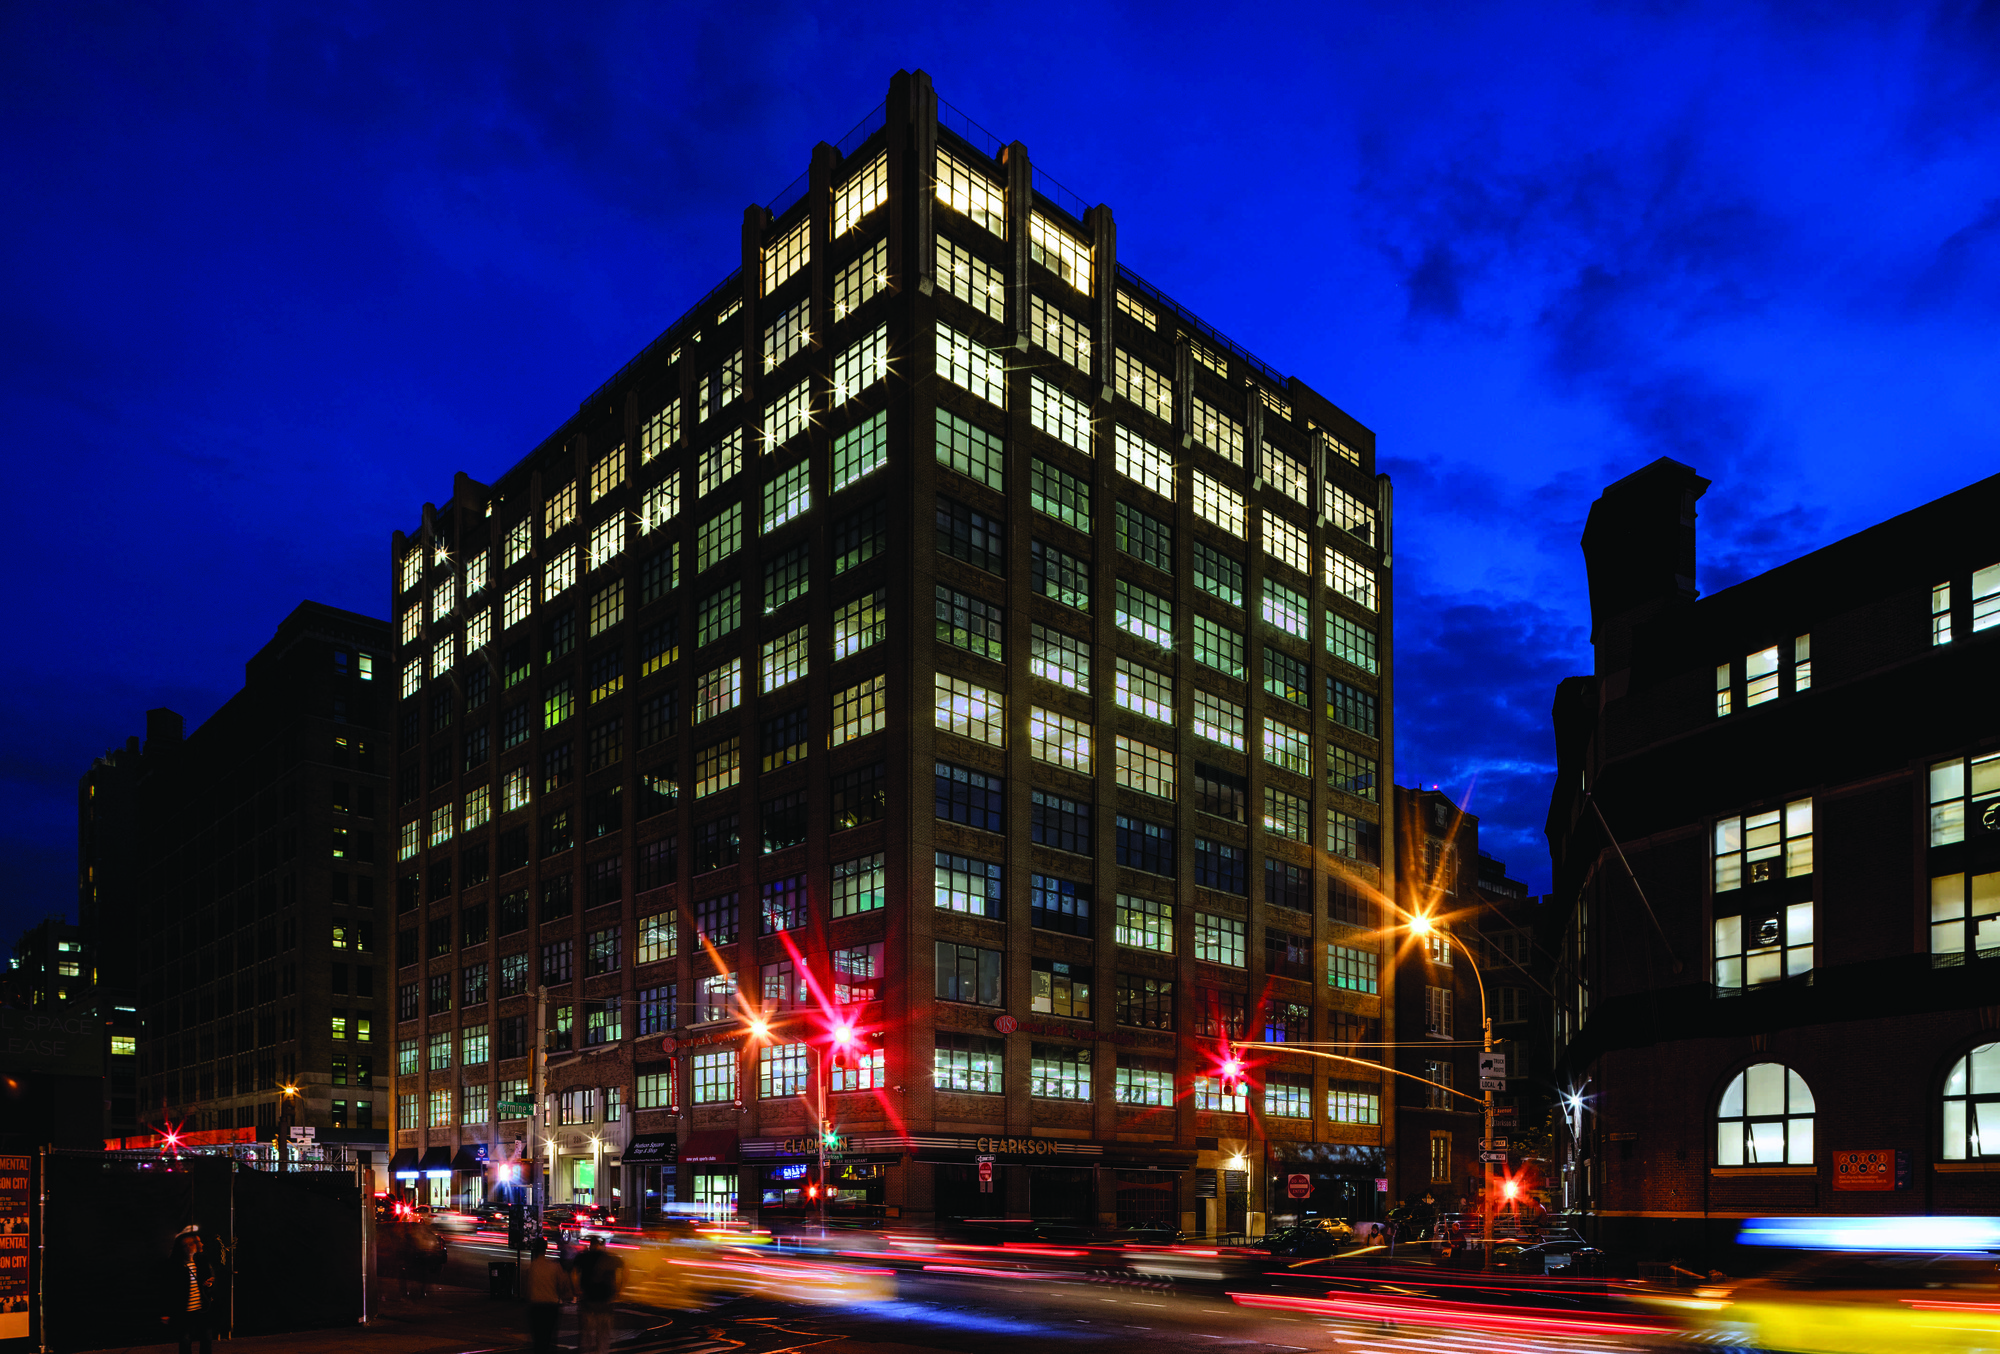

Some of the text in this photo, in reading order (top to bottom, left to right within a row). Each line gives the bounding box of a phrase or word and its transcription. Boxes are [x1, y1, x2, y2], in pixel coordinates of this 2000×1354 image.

[23, 1015, 94, 1034] SPACE
[1018, 1022, 1044, 1034] new
[1045, 1024, 1069, 1037] york
[498, 1102, 526, 1113] Carmine
[977, 1137, 1057, 1155] CLARKSON
[13, 1177, 28, 1189] CITY
[0, 1256, 27, 1268] ON CITY
